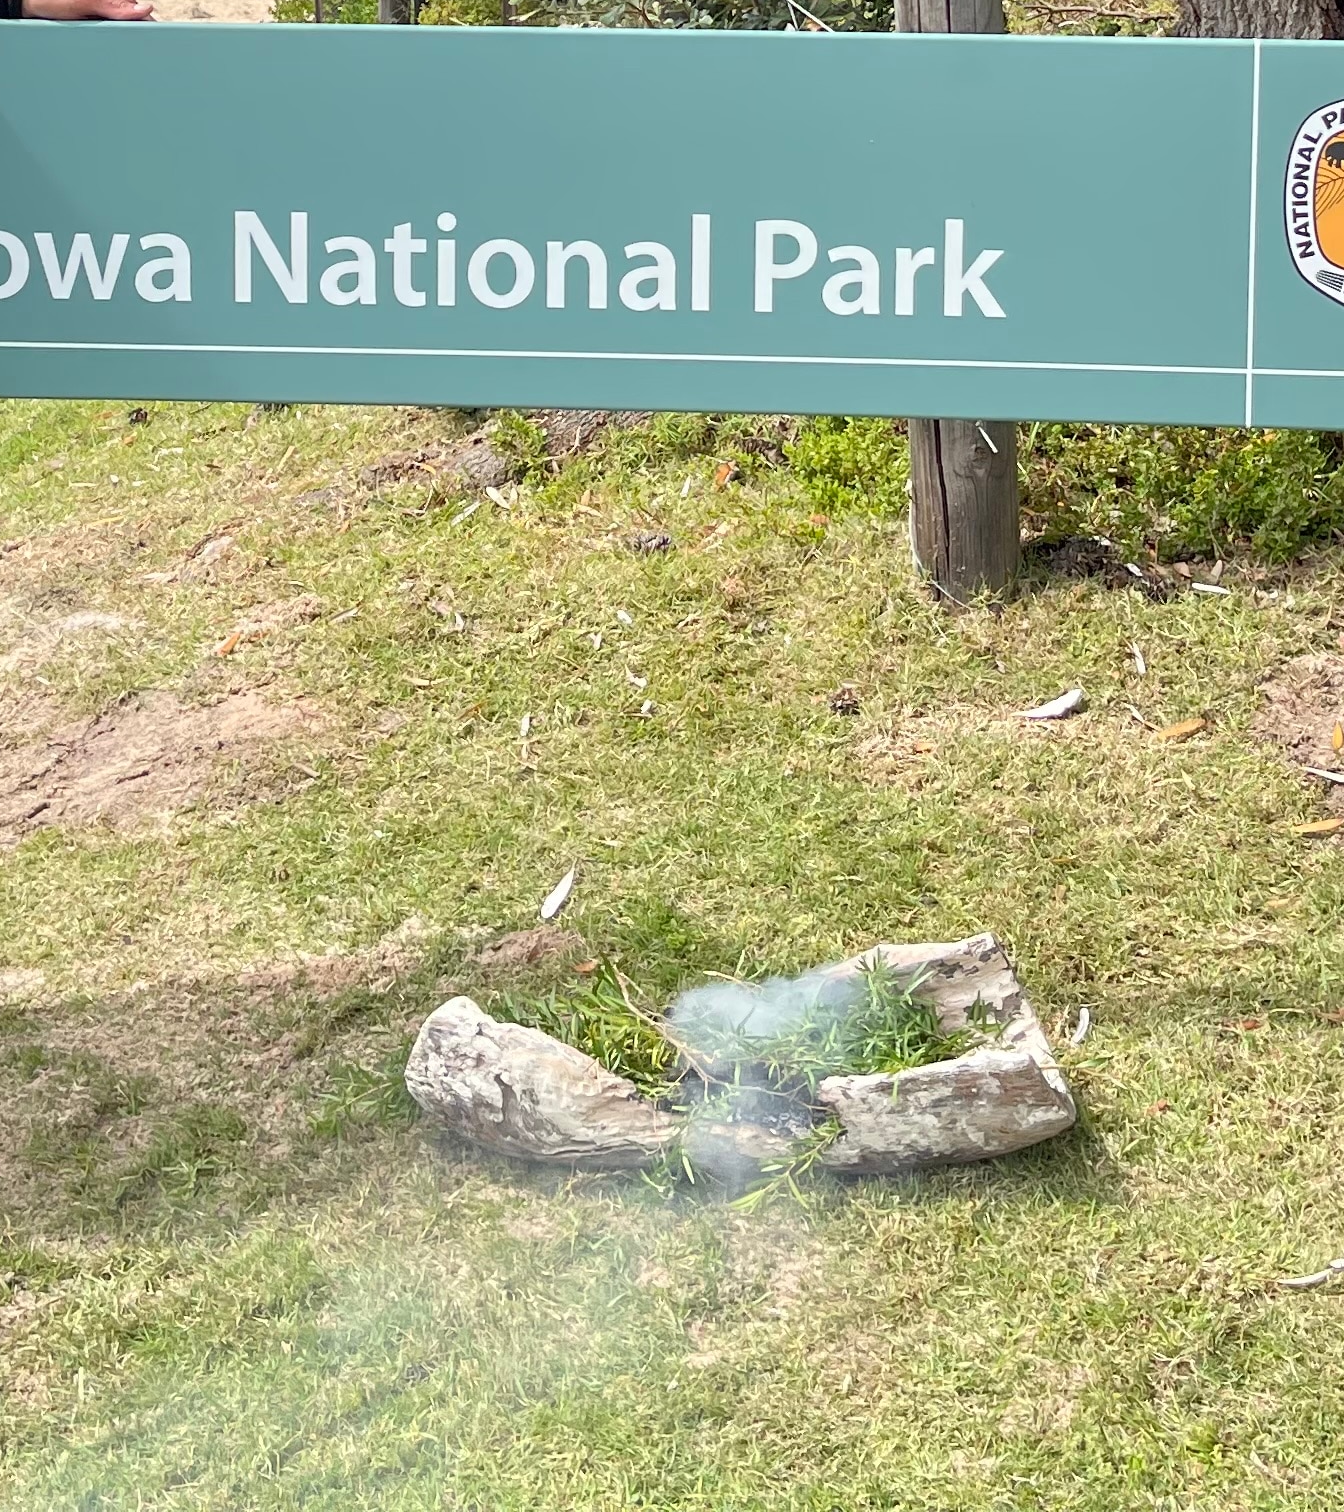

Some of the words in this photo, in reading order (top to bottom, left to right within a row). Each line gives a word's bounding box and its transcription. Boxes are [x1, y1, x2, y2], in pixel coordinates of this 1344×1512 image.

[1291, 129, 1322, 259] NATIONAL
[234, 210, 711, 313] National
[754, 219, 1008, 318] Park
